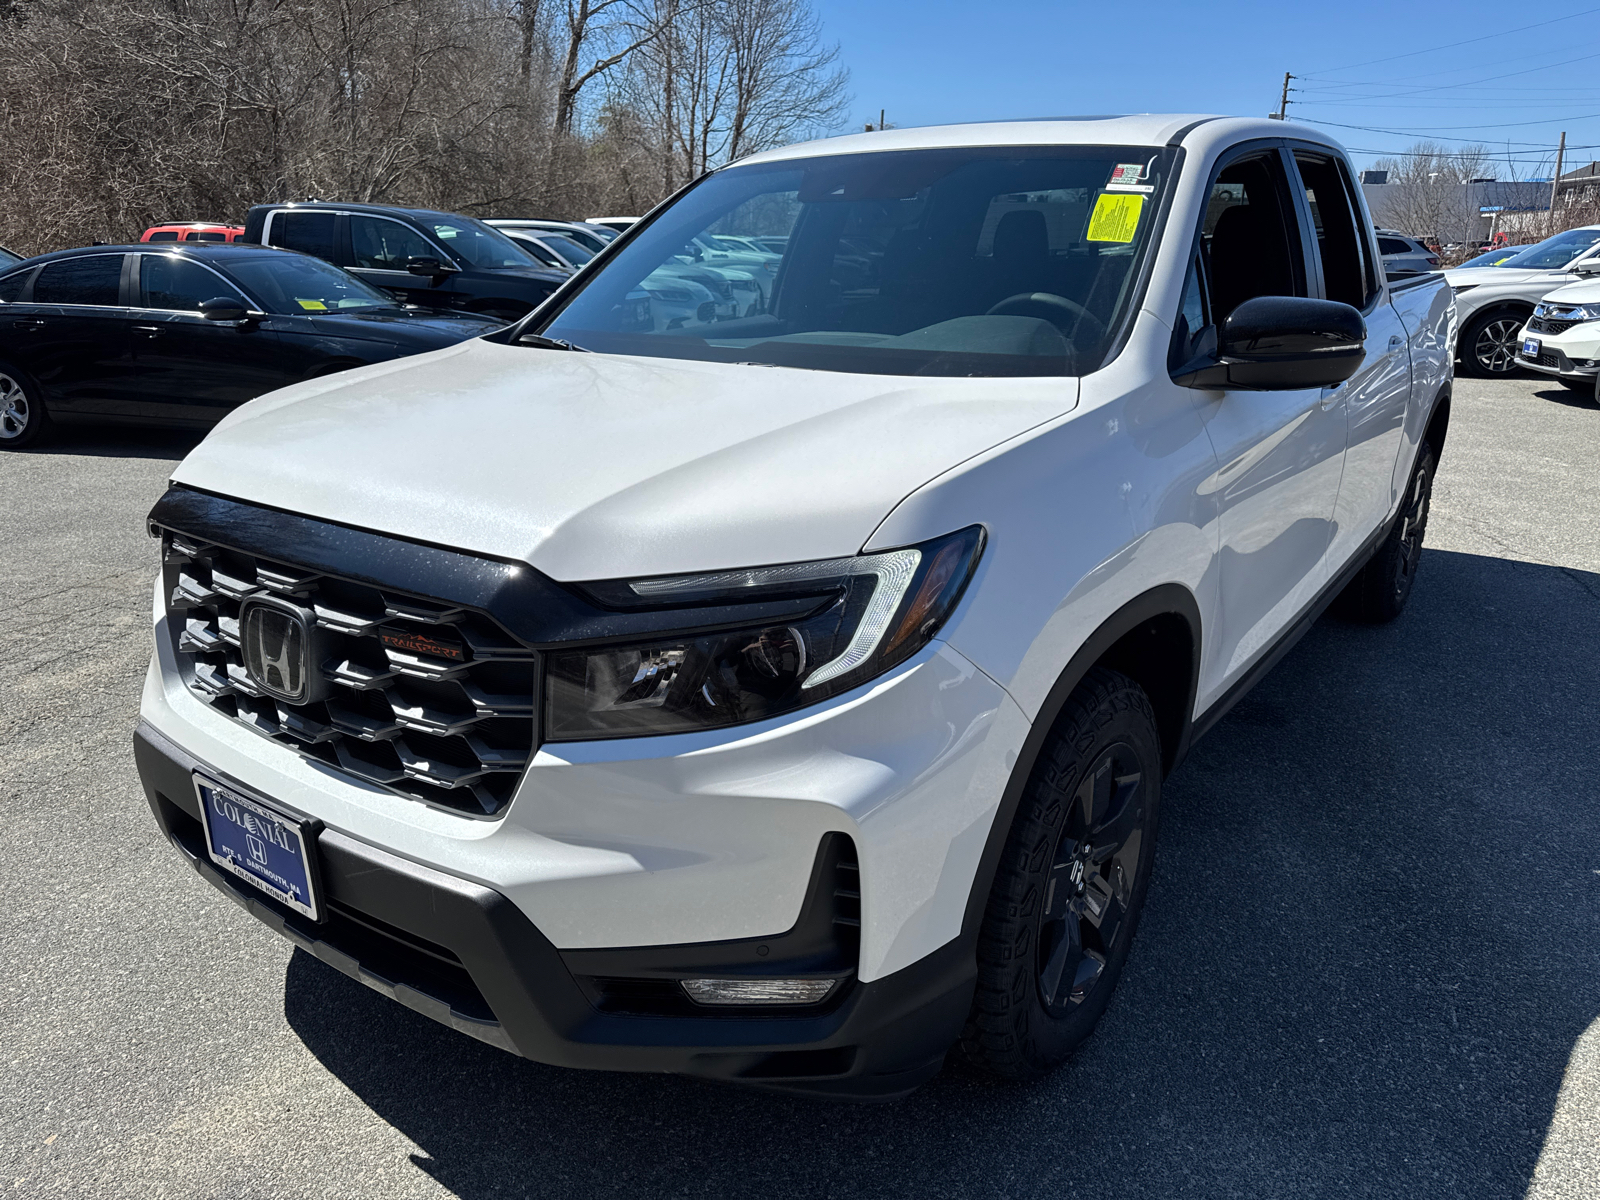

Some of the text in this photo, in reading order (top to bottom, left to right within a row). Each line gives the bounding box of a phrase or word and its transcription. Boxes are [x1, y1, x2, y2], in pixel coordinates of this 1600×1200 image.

[382, 635, 460, 658] TRAILSPORT
[213, 797, 295, 855] COLONIAL
[222, 844, 243, 862] RTE. 6
[233, 867, 290, 905] COLONIAL HONDA
[246, 858, 302, 896] DARTMOUTH, MA
